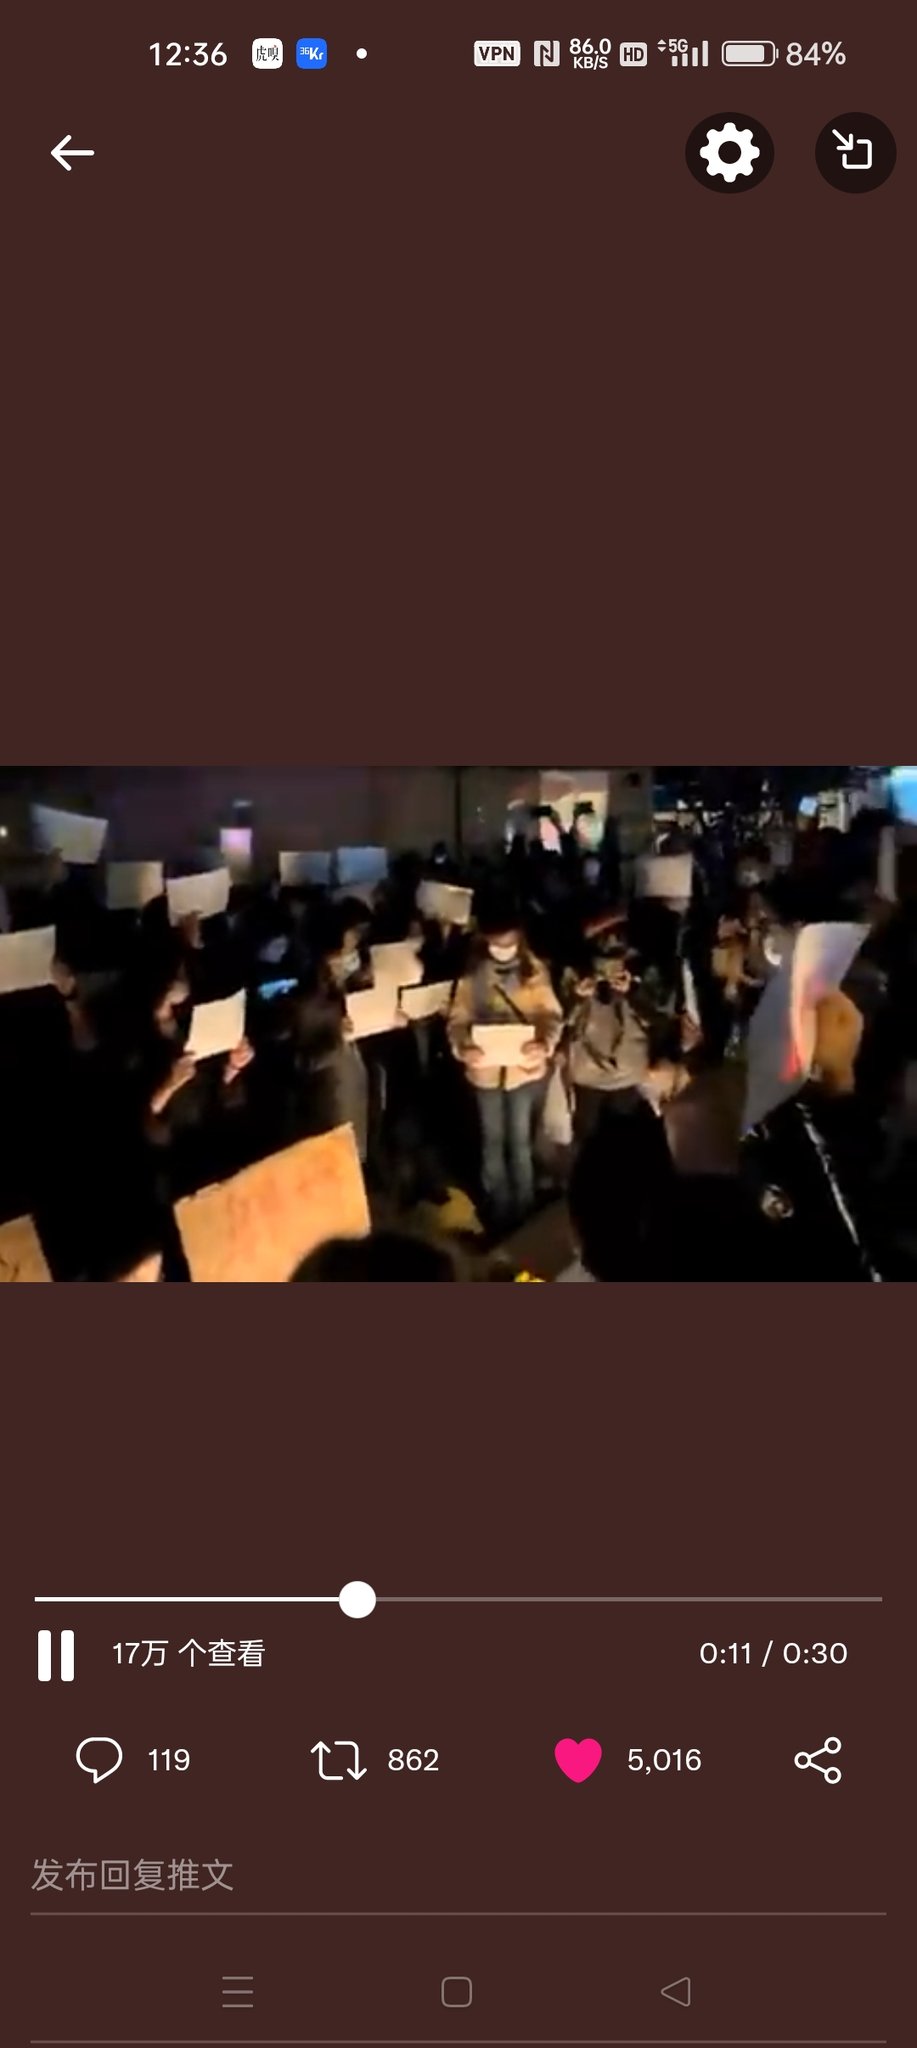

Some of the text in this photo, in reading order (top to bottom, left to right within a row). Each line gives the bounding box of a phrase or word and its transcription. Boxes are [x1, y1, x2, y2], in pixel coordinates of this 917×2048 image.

[148, 42, 228, 66] 12:36
[478, 46, 516, 61] VPN
[569, 38, 612, 55] 86.0
[623, 47, 645, 62] HD
[668, 38, 689, 53] 5G
[785, 41, 847, 66] 84%
[573, 55, 609, 70] KB/S
[112, 1638, 266, 1668] 17万 个查看
[699, 1640, 848, 1667] 0:11 / 0:30
[148, 1749, 191, 1772] 119
[387, 1749, 439, 1772] 862
[627, 1749, 702, 1776] 5,016
[30, 1857, 234, 1892] 发布回复推文
